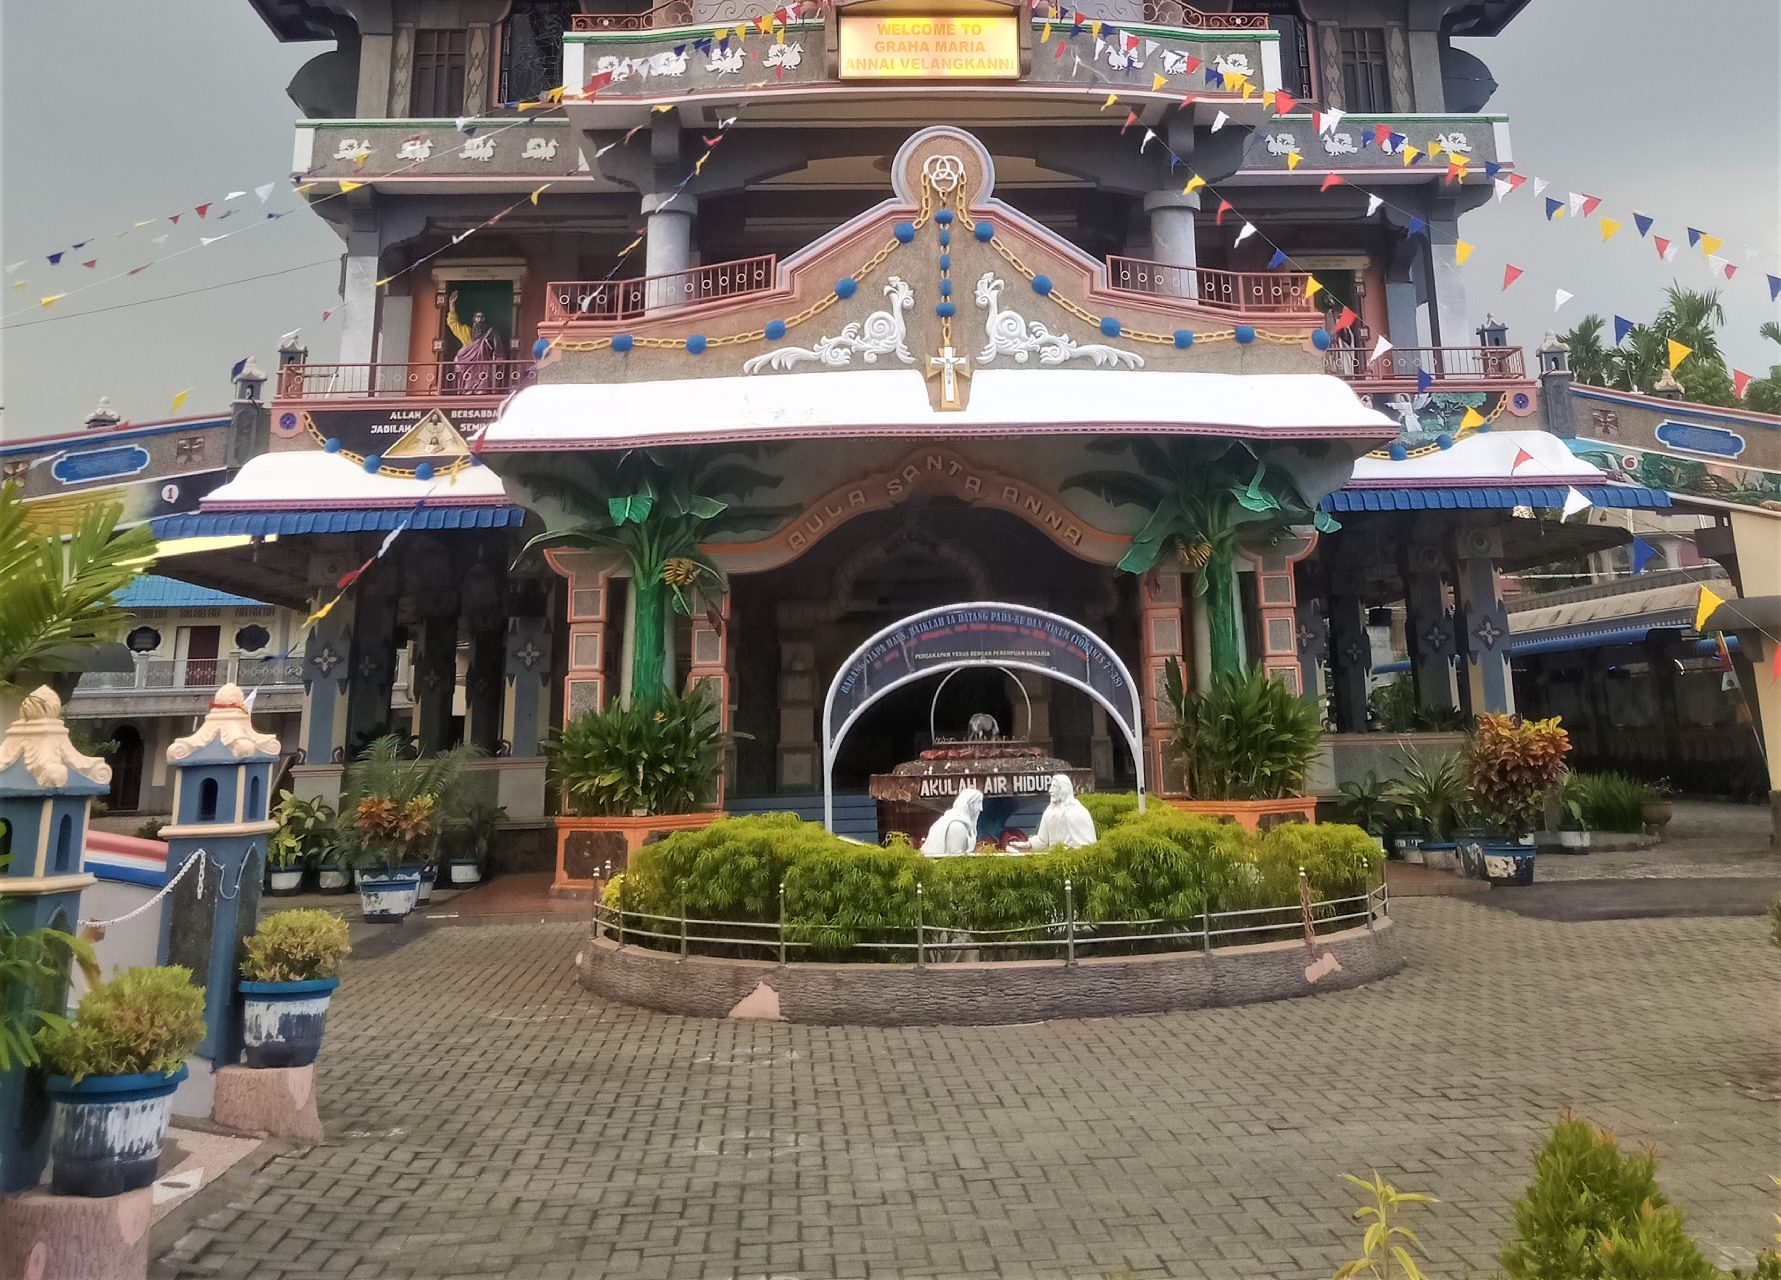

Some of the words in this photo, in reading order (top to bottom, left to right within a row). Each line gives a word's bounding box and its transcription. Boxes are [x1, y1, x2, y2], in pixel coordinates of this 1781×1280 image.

[877, 23, 955, 36] WELCOME
[961, 23, 982, 36] TO
[874, 40, 930, 53] GRAHA
[935, 40, 985, 53] MARIA
[845, 57, 894, 71] ANNAI
[900, 57, 1015, 70] VELANGKANNI
[389, 411, 421, 420] ALLAH
[451, 410, 498, 419] BERSABDA
[371, 424, 411, 434] JADILAH
[789, 489, 867, 552] AULA
[887, 455, 982, 497] SANTA
[1001, 486, 1083, 547] ANNA
[946, 615, 956, 625] IA
[958, 612, 989, 623] DATANG
[1026, 617, 1043, 630] DAN
[914, 651, 951, 660] PERCAKAPAN
[920, 777, 977, 796] AKULAH
[984, 776, 1007, 794] AIR
[1013, 775, 1052, 793] HIDUP
